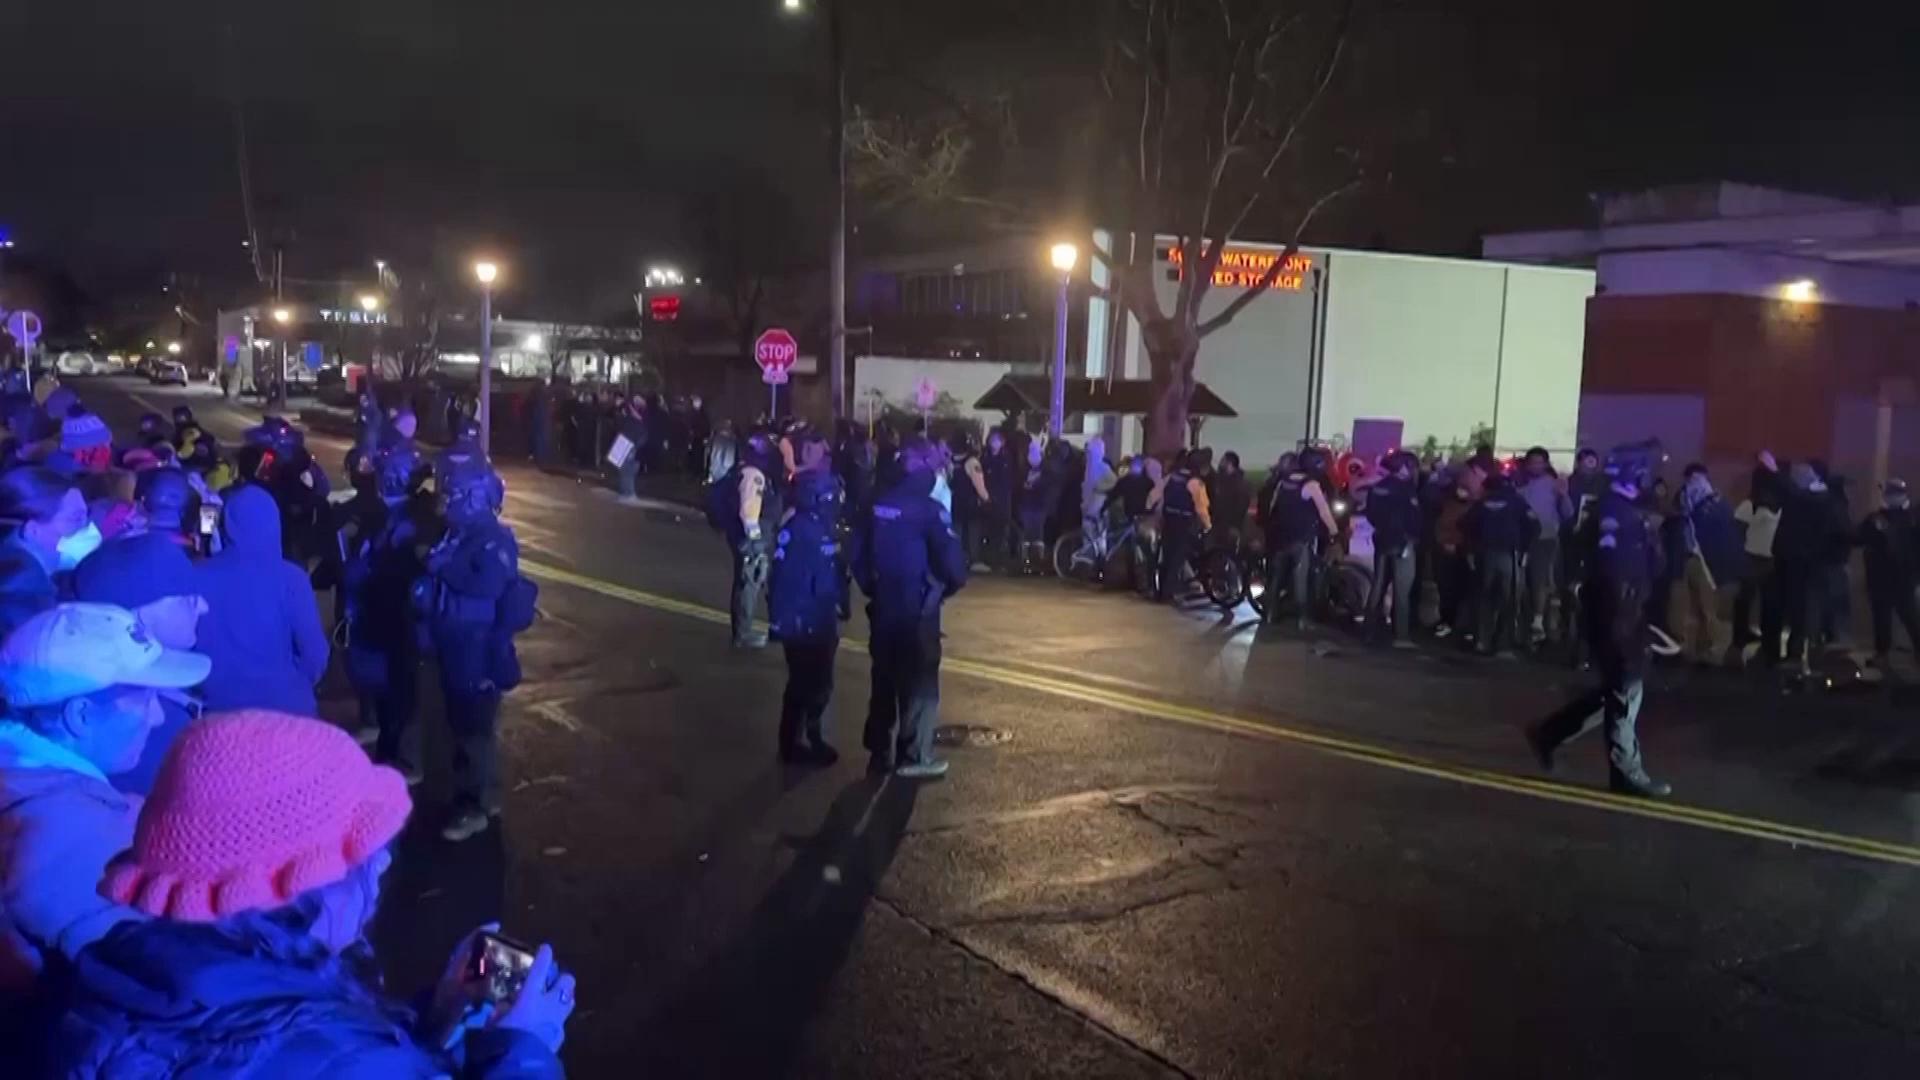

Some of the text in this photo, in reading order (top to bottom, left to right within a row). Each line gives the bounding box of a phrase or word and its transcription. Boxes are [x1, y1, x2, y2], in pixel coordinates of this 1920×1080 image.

[1221, 252, 1312, 272] WATERFONT
[1238, 272, 1303, 289] STOAGE
[759, 344, 793, 360] STOP
